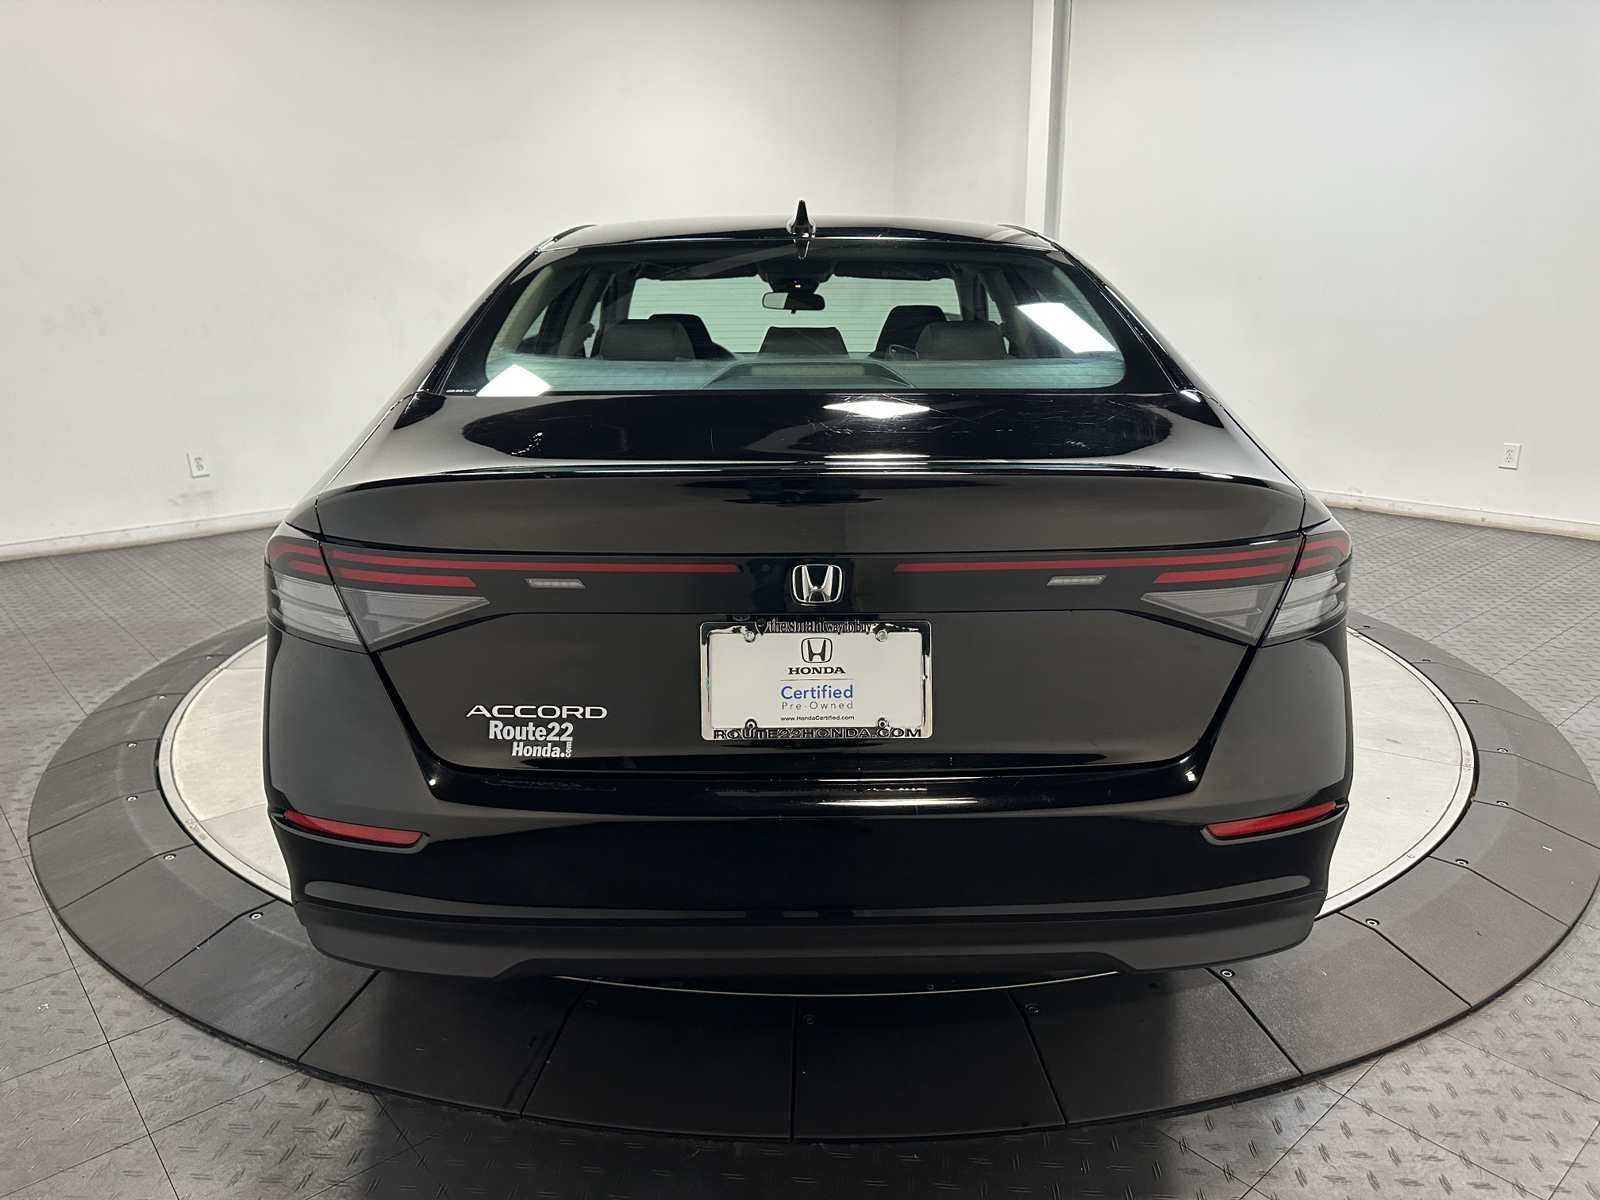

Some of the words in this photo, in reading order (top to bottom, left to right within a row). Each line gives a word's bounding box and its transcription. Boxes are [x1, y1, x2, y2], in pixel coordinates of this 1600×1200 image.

[788, 666, 846, 675] HONDA
[780, 684, 854, 699] Certified
[466, 704, 608, 719] ACCORD
[781, 701, 854, 710] Pre-Owned
[488, 720, 574, 742] Route22
[713, 727, 922, 739] ROUTE22HONDA.COM
